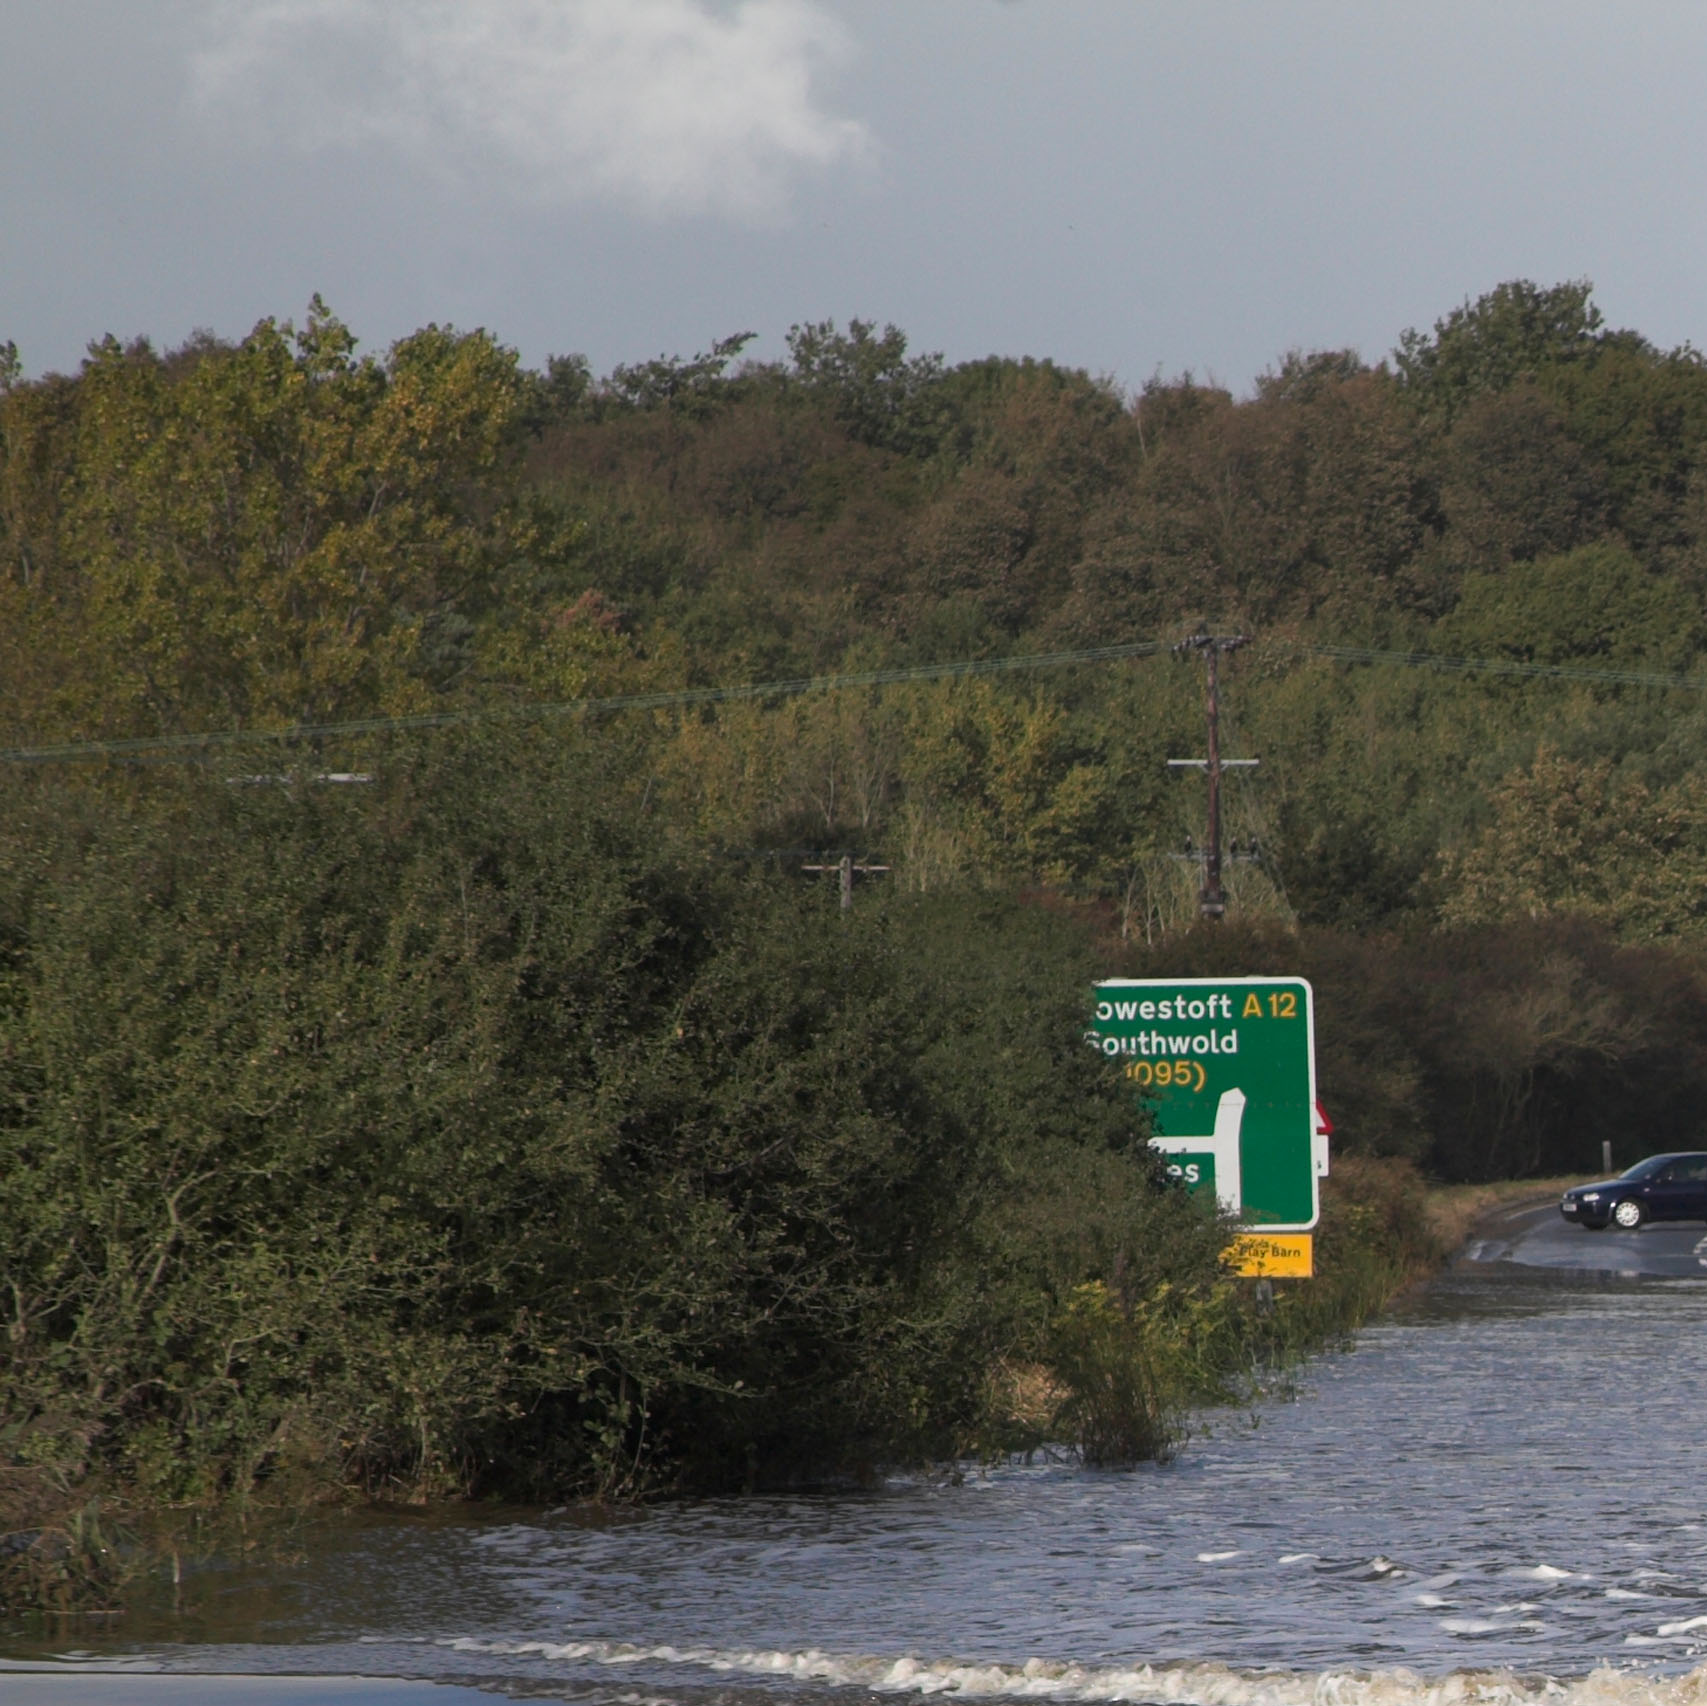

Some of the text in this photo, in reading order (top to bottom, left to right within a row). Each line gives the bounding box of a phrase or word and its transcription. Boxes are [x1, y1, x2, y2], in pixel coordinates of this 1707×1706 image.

[1095, 993, 1233, 1020] owestoft
[1125, 1060, 1206, 1092] 1095)
[1271, 1245, 1301, 1257] Barn
